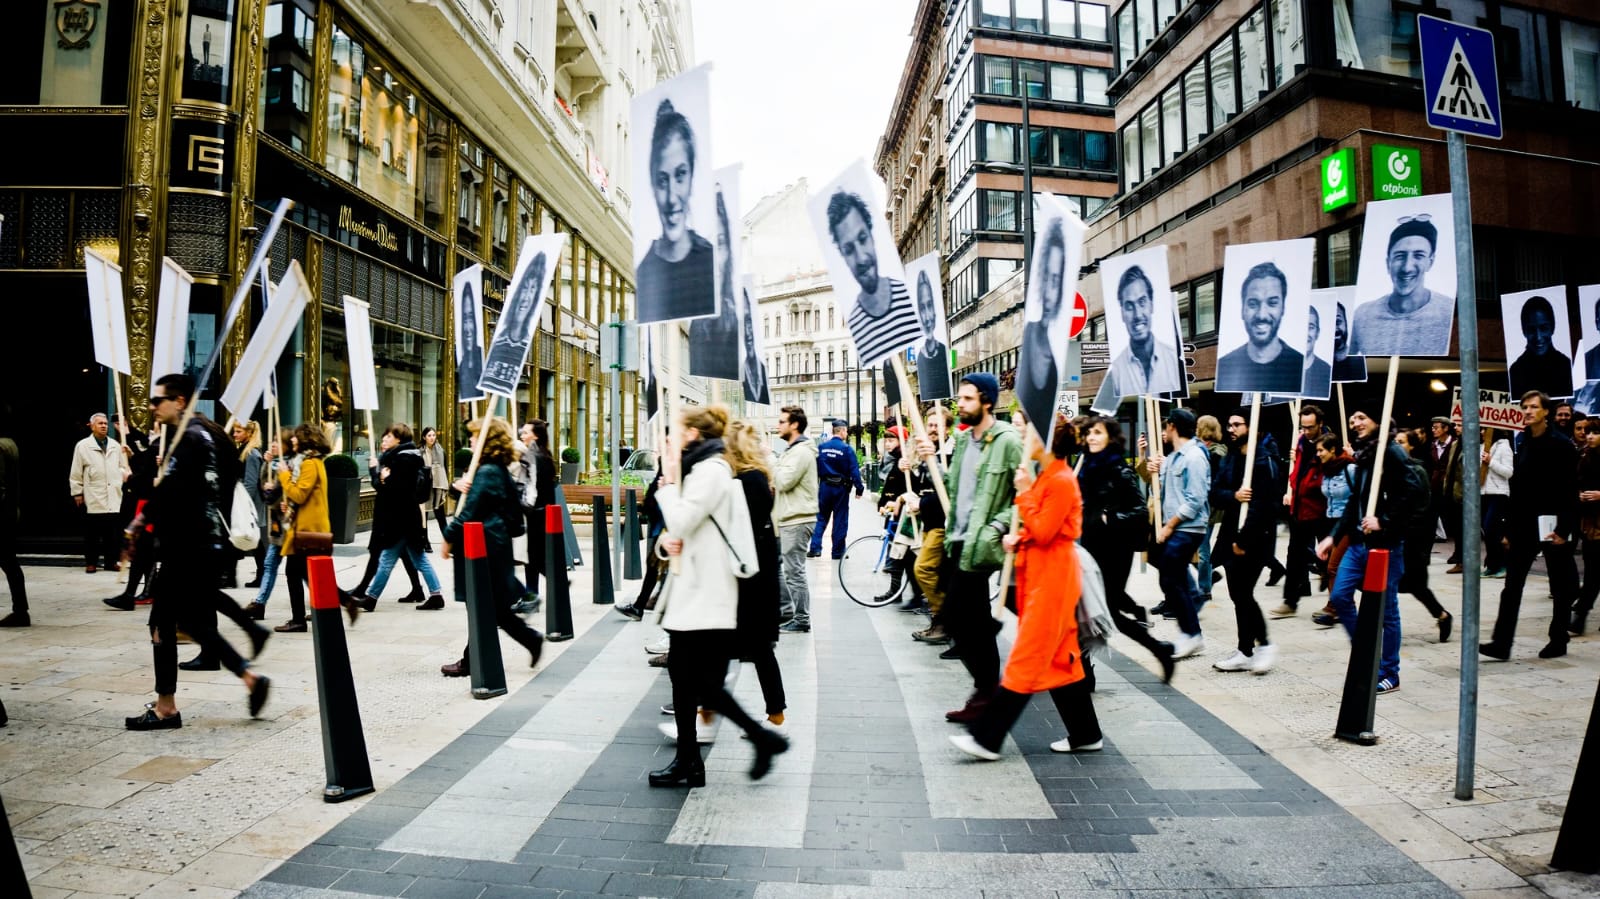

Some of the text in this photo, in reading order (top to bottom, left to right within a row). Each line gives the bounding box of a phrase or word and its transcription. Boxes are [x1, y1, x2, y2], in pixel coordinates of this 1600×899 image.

[1382, 183, 1418, 196] otpbank
[1455, 389, 1494, 403] TRA
[1452, 403, 1530, 426] ANTGARD
